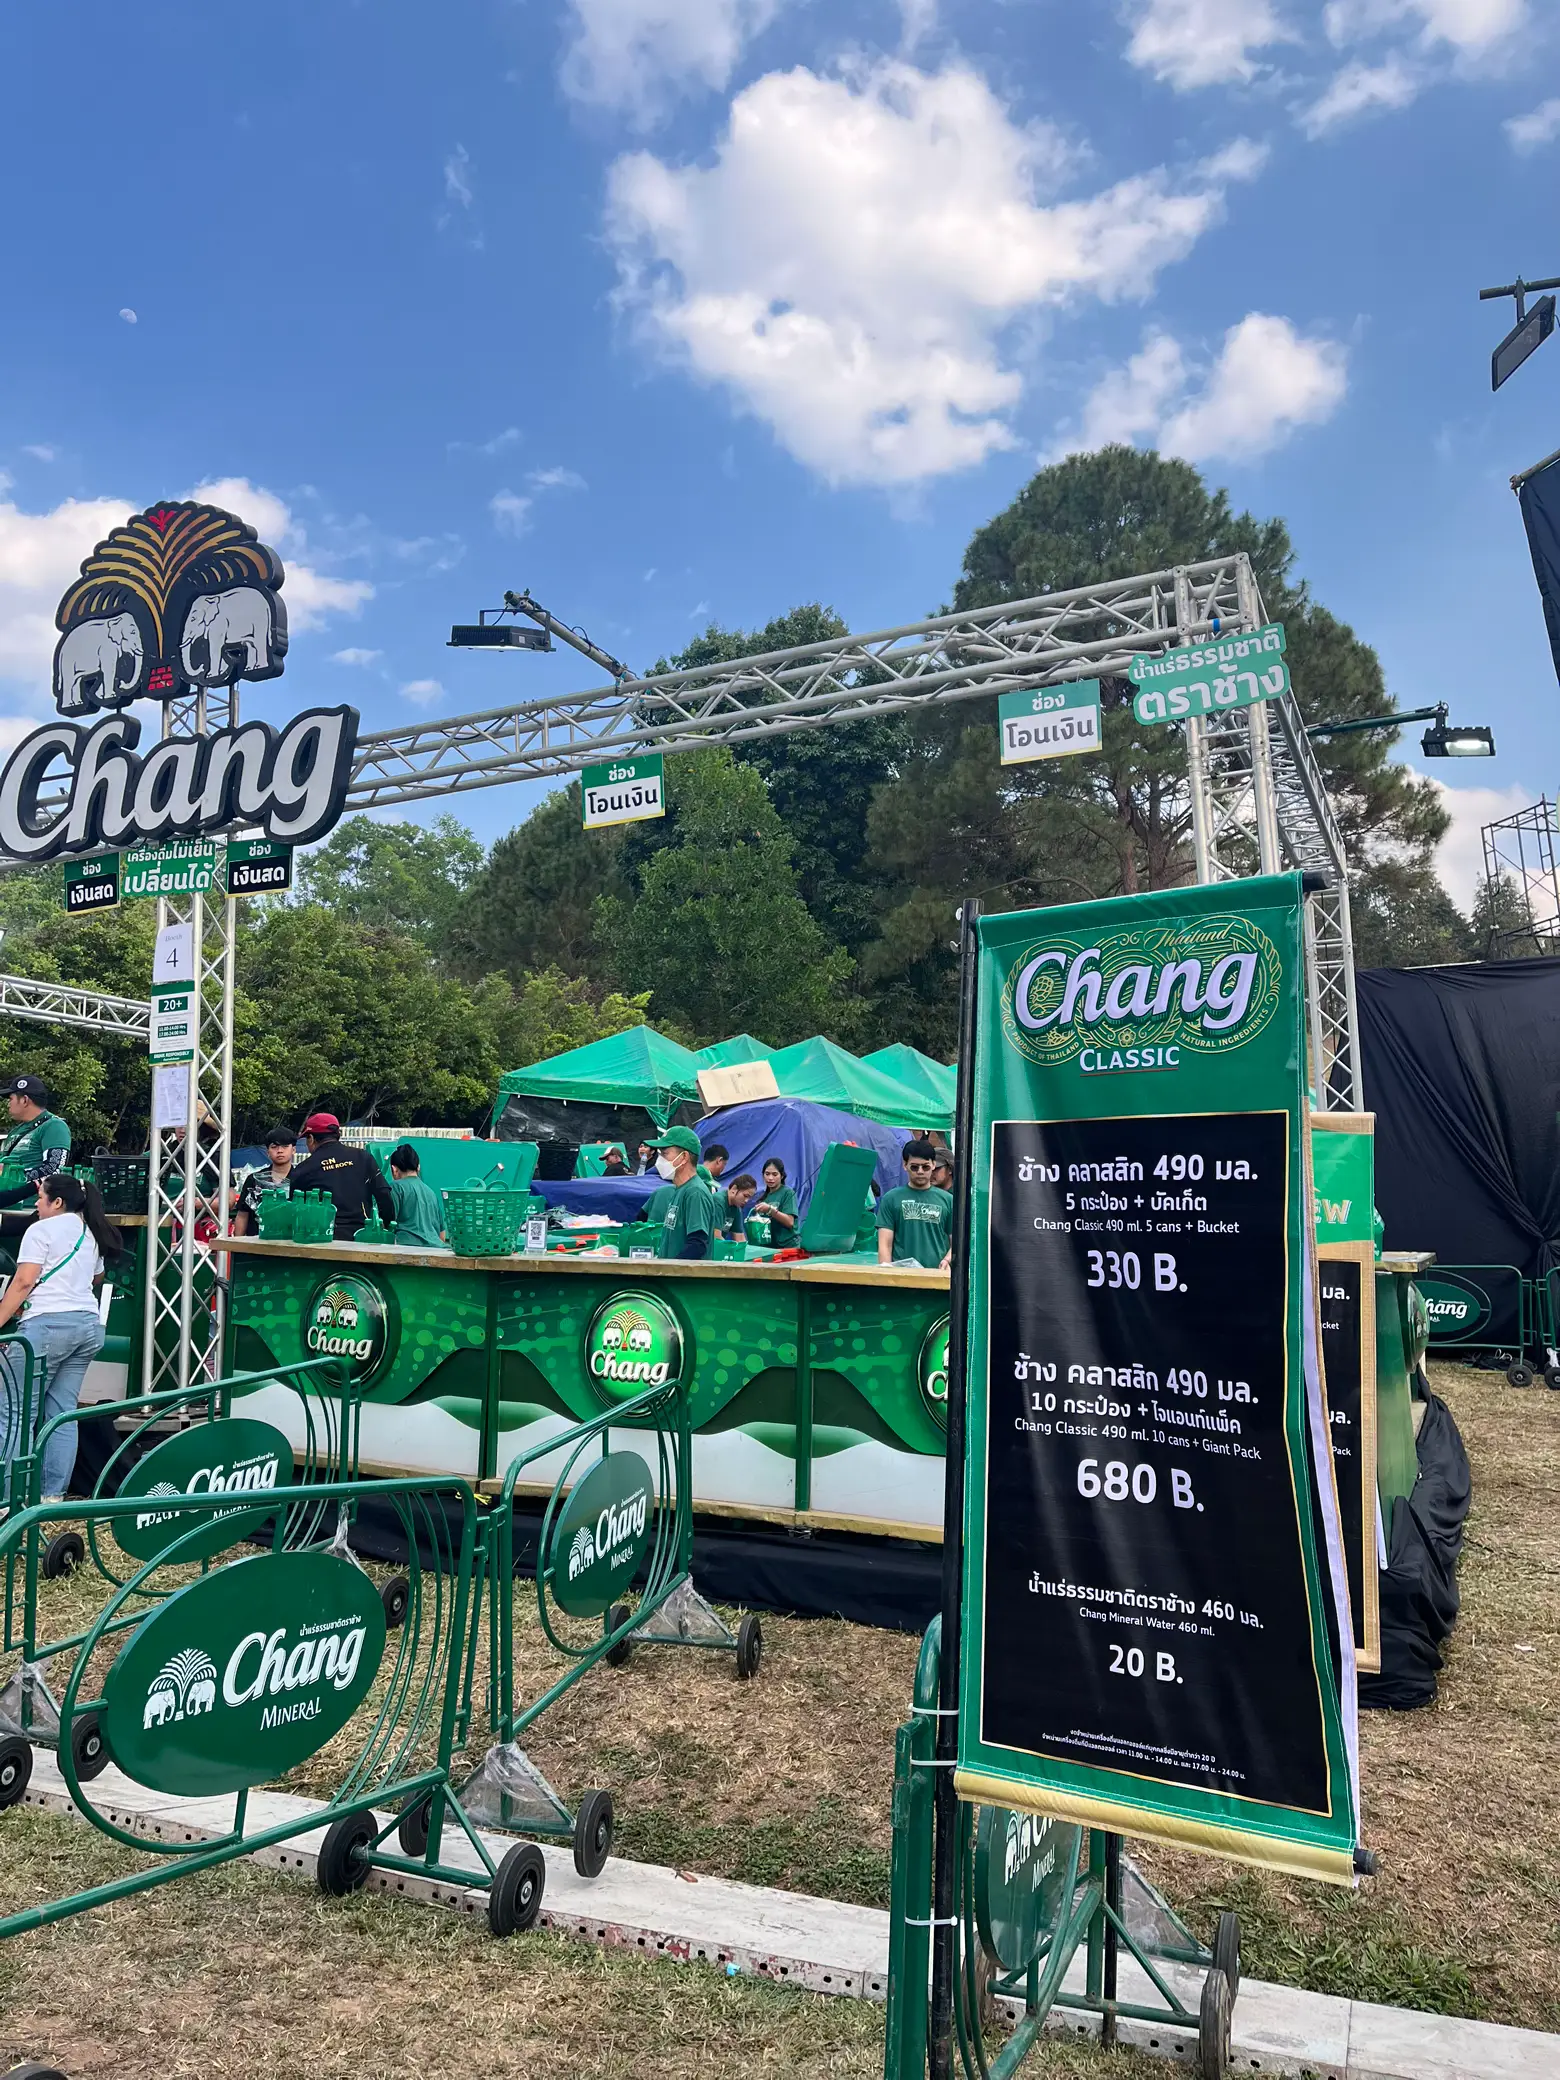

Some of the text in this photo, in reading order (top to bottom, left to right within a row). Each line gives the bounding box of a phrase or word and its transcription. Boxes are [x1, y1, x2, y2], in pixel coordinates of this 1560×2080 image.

[1133, 628, 1281, 680] น้ำแร่ธรรมชาติ
[1031, 691, 1066, 712] ช่อง
[1138, 663, 1285, 720] ตราช้าง
[1006, 716, 1095, 749] โอนเงิน
[1, 712, 346, 856] Chang
[608, 763, 636, 782] ช่อง
[587, 786, 659, 815] โอนเงิน
[249, 842, 272, 857] ช่อง
[82, 860, 101, 876] ช่อง
[124, 860, 213, 894] เปลี่ยนได้
[233, 864, 286, 886] เงินสด
[70, 882, 114, 905] เงินสด
[166, 947, 179, 968] 4
[163, 999, 182, 1011] 20+
[1015, 947, 1259, 1031] Chang
[1179, 1007, 1269, 1048] NATURAL INGREDIENTS
[1011, 1031, 1039, 1058] PRODUCT
[1045, 1041, 1081, 1062] THAILAND
[1018, 1154, 1259, 1182] ช้าง คลาสสิก 490 มล.
[1065, 1188, 1207, 1211] 5 กระป๋อง + บัคเก็ต
[1033, 1217, 1240, 1234] Chang Classic 490 ml. 5 cans + Bucket
[1087, 1249, 1188, 1293] 330 B.
[1424, 1297, 1468, 1320] hang
[306, 1325, 373, 1361] Chang
[589, 1349, 670, 1386] Chang
[1014, 1352, 1260, 1405] ช้าง คลาสสิก 490 มล.
[1031, 1392, 1242, 1435] 10 กระป๋อง + ไจแอนท์แพ็ค
[1014, 1417, 1262, 1461] Chang Classic 490 ml. 10 cans + Giant Pack
[1076, 1458, 1205, 1513] 680 B.
[595, 1493, 648, 1560] Chang
[1028, 1570, 1265, 1630] น้ำแร่ธรรมชาติตราช้าง 460 มล.
[1079, 1606, 1216, 1637] Chang Mineral Water 460 ml.
[222, 1626, 367, 1708] Chang
[1108, 1643, 1184, 1685] 20 B.
[260, 1696, 323, 1731] MINERAL
[1128, 1750, 1143, 1760] 11.00
[1155, 1755, 1173, 1765] 14.00
[1192, 1762, 1209, 1772] 17.00
[1221, 1768, 1239, 1778] 24.00
